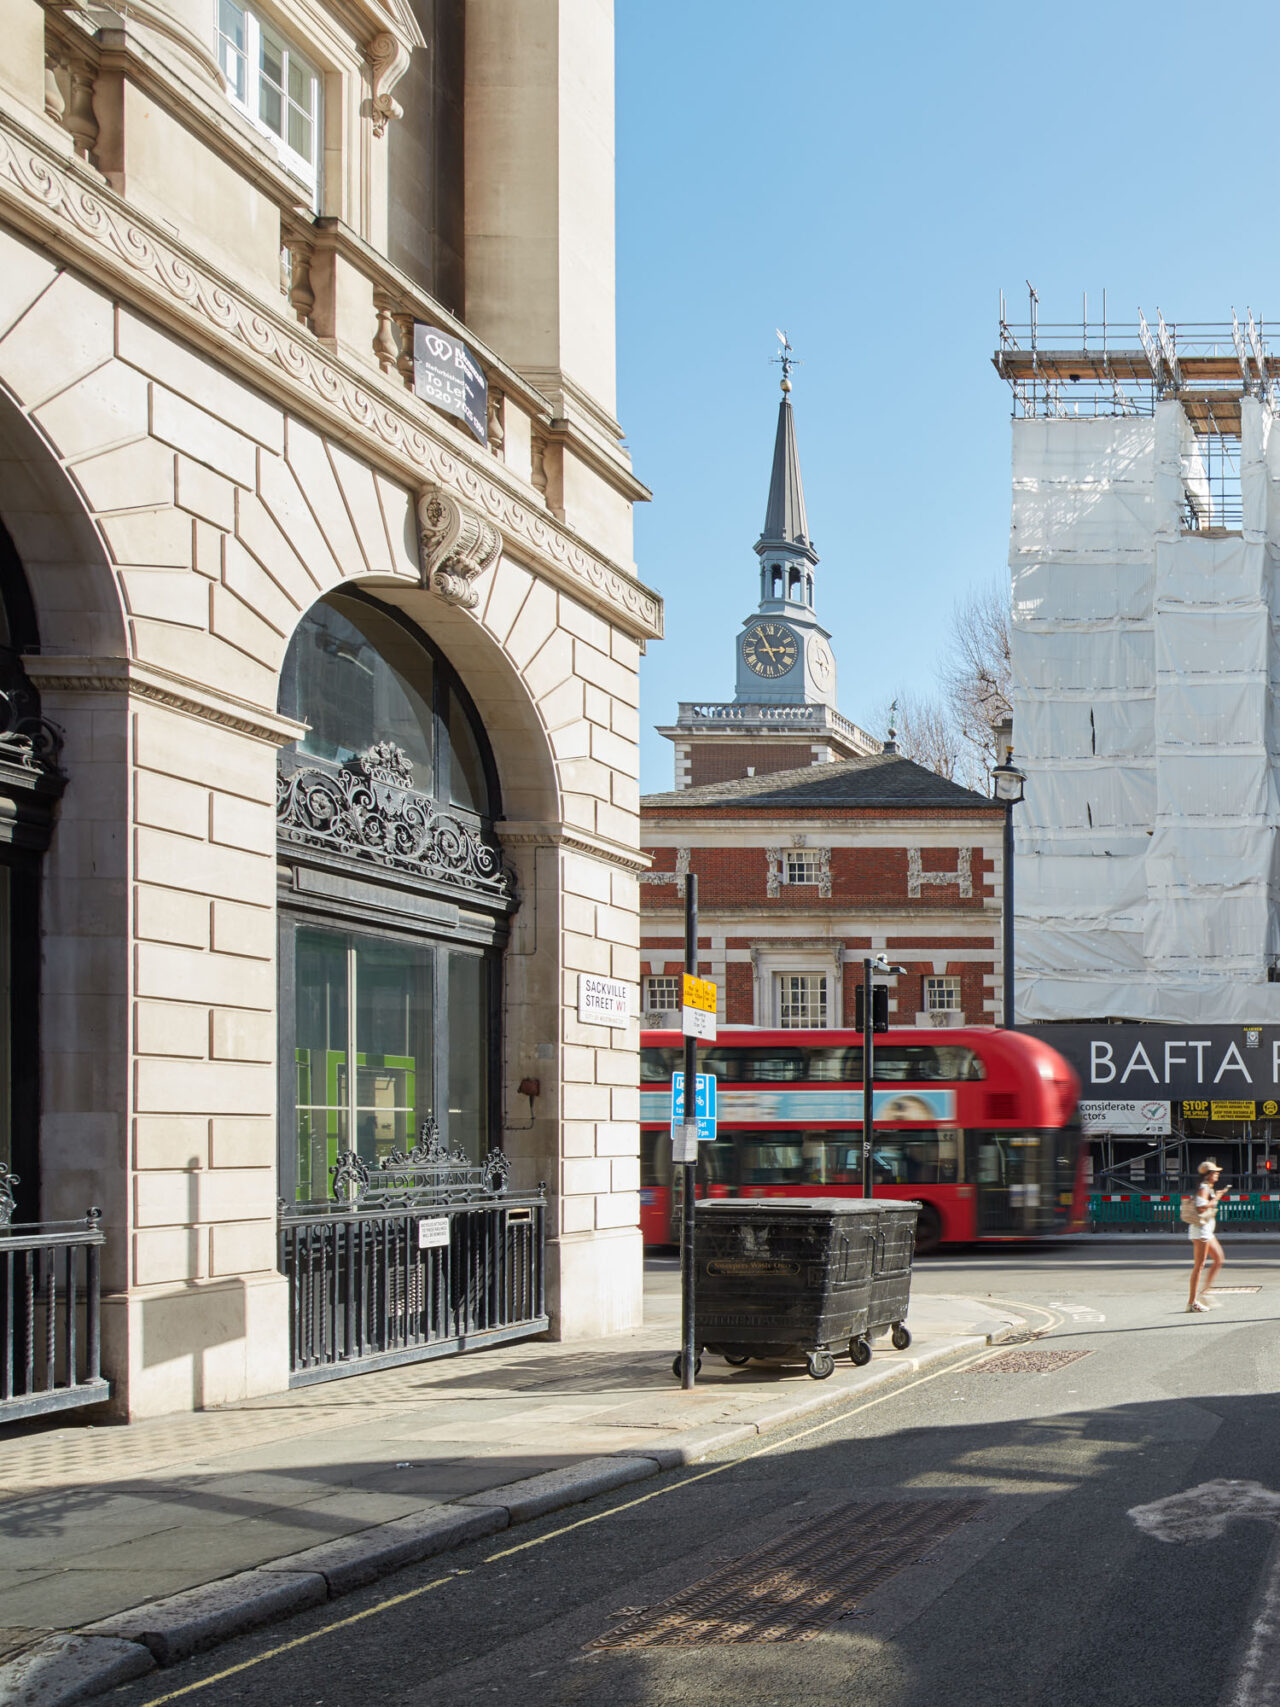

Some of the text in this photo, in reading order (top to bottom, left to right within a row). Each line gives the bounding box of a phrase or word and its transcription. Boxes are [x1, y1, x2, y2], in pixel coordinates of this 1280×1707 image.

[425, 370, 466, 400] To Let
[426, 385, 452, 404] 020
[585, 979, 626, 999] SACKVILLE
[585, 994, 626, 1012] STREET W1
[1090, 1041, 1253, 1084] BAFTA
[1080, 1102, 1136, 1112] considerate
[1182, 1100, 1209, 1111] STOP
